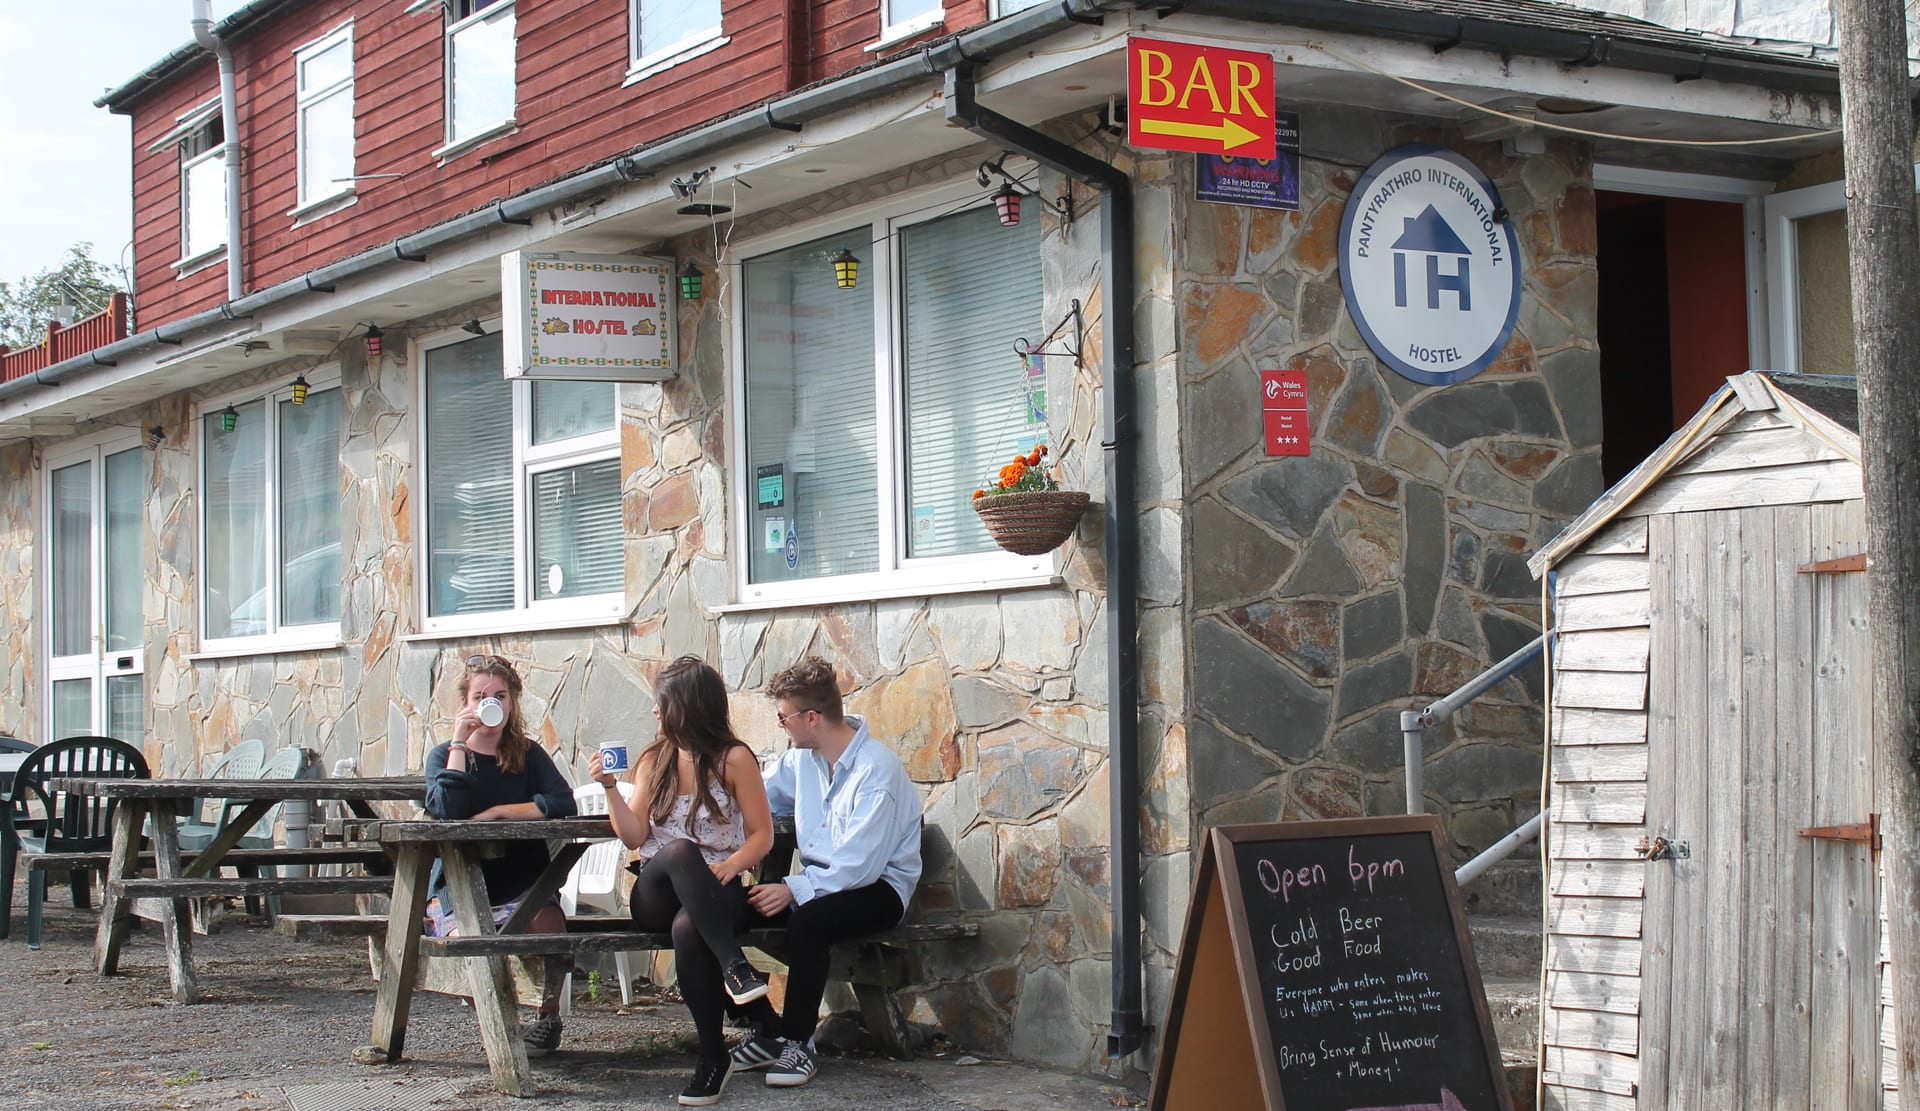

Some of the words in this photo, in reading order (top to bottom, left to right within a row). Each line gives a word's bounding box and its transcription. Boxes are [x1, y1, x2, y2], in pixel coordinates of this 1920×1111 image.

[1138, 48, 1269, 119] BAR
[1213, 163, 1280, 183] WARNING
[1240, 179, 1250, 187] HD
[1251, 180, 1270, 189] CCTV
[1358, 168, 1422, 258] PANTYRATHRO
[1427, 168, 1503, 267] INTERNATIONAL
[541, 289, 656, 308] INTERNATIONAL
[572, 318, 628, 335] HOSTEL
[1409, 343, 1462, 364] HOSTEL
[1282, 381, 1301, 389] Wales
[1283, 390, 1304, 399] Cymru
[1257, 859, 1326, 903] Open
[1348, 844, 1404, 894] 6pm
[1271, 914, 1319, 949] Cold
[1339, 907, 1383, 935] Beer
[1277, 945, 1321, 973] Good
[1343, 934, 1382, 958] Food
[1276, 986, 1323, 1002] Everyone
[1330, 977, 1349, 992] who
[1354, 973, 1385, 989] enters
[1396, 967, 1429, 984] makes
[1303, 999, 1335, 1014] HAPPY
[1373, 993, 1393, 1005] when
[1394, 991, 1415, 1003] they
[1418, 987, 1441, 999] enter
[1376, 1007, 1394, 1016] when
[1398, 1005, 1417, 1015] they
[1280, 1045, 1316, 1070] Bring
[1320, 1039, 1355, 1060] Sense
[1361, 1036, 1371, 1055] of
[1378, 1032, 1440, 1052] Humour
